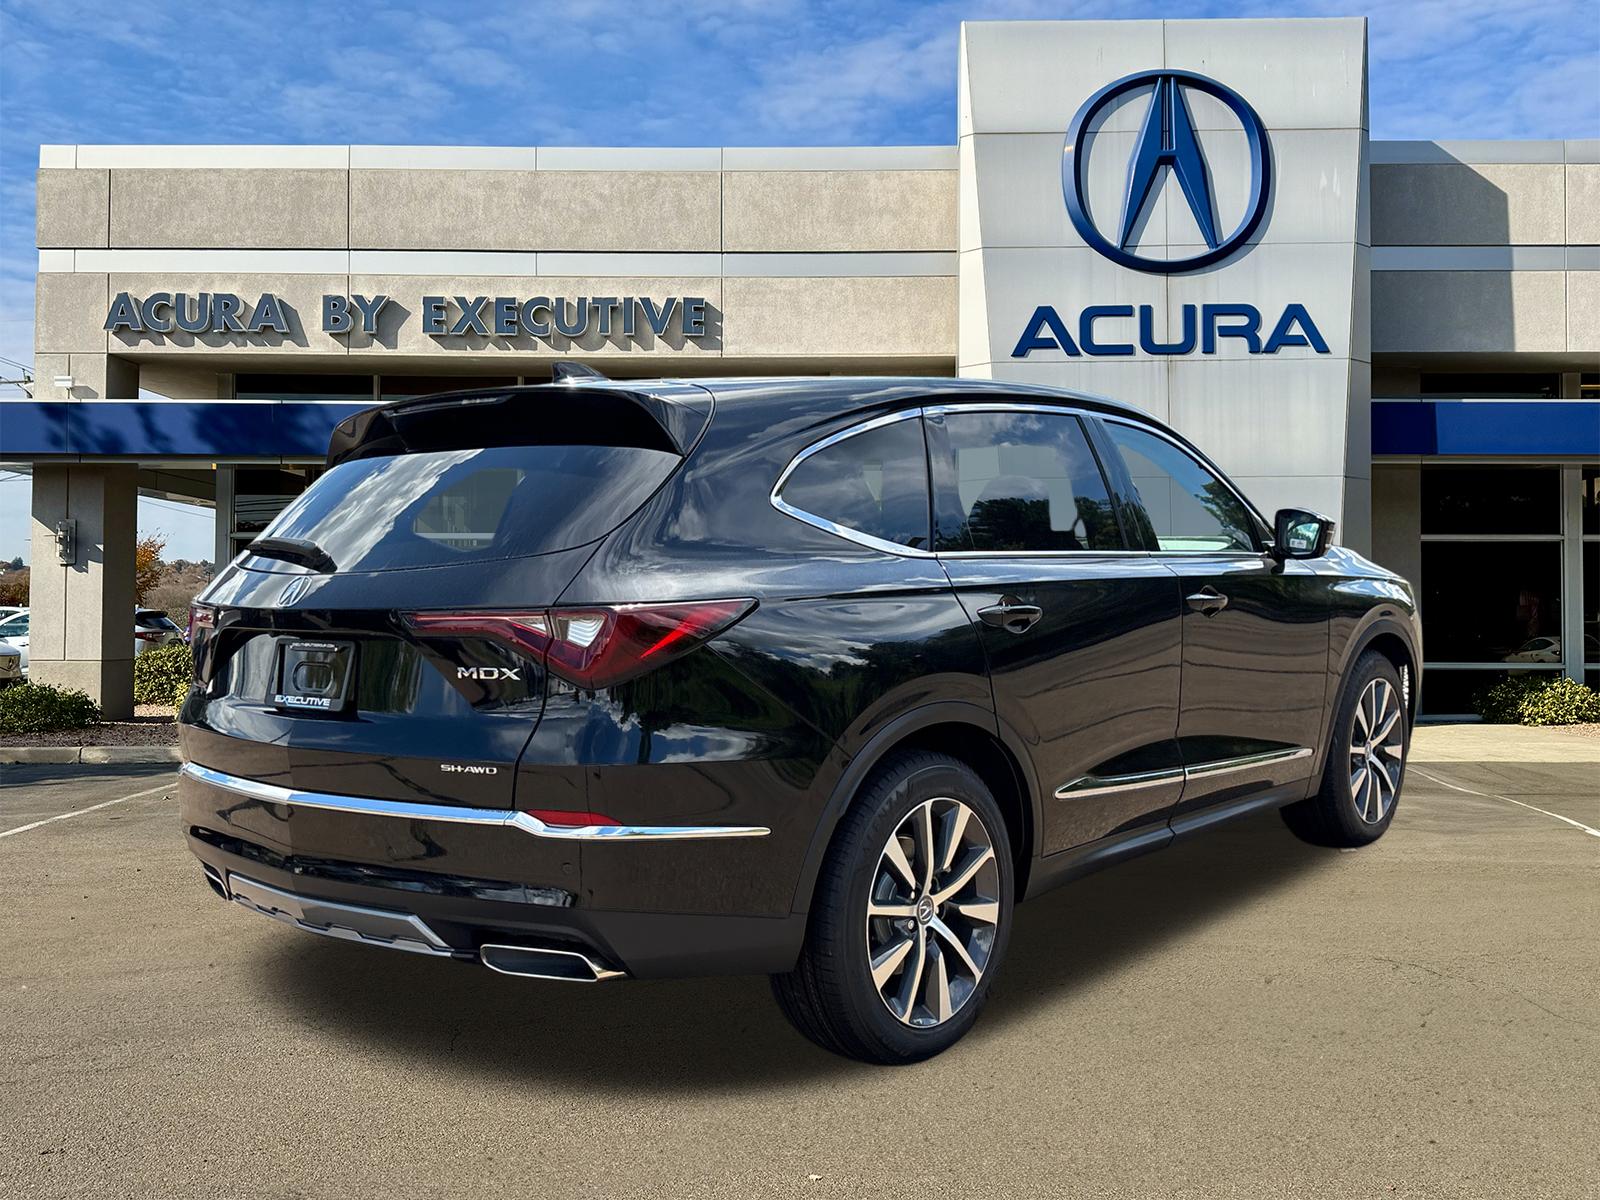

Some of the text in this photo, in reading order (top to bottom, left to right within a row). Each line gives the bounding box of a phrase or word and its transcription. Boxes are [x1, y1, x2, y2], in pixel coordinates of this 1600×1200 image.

[103, 292, 706, 336] ACURA BY EXECUTIVE
[1011, 304, 1331, 357] ACURA
[457, 666, 521, 680] MDX
[274, 694, 331, 707] EXECUTIVE
[440, 764, 498, 775] SH-AWD
